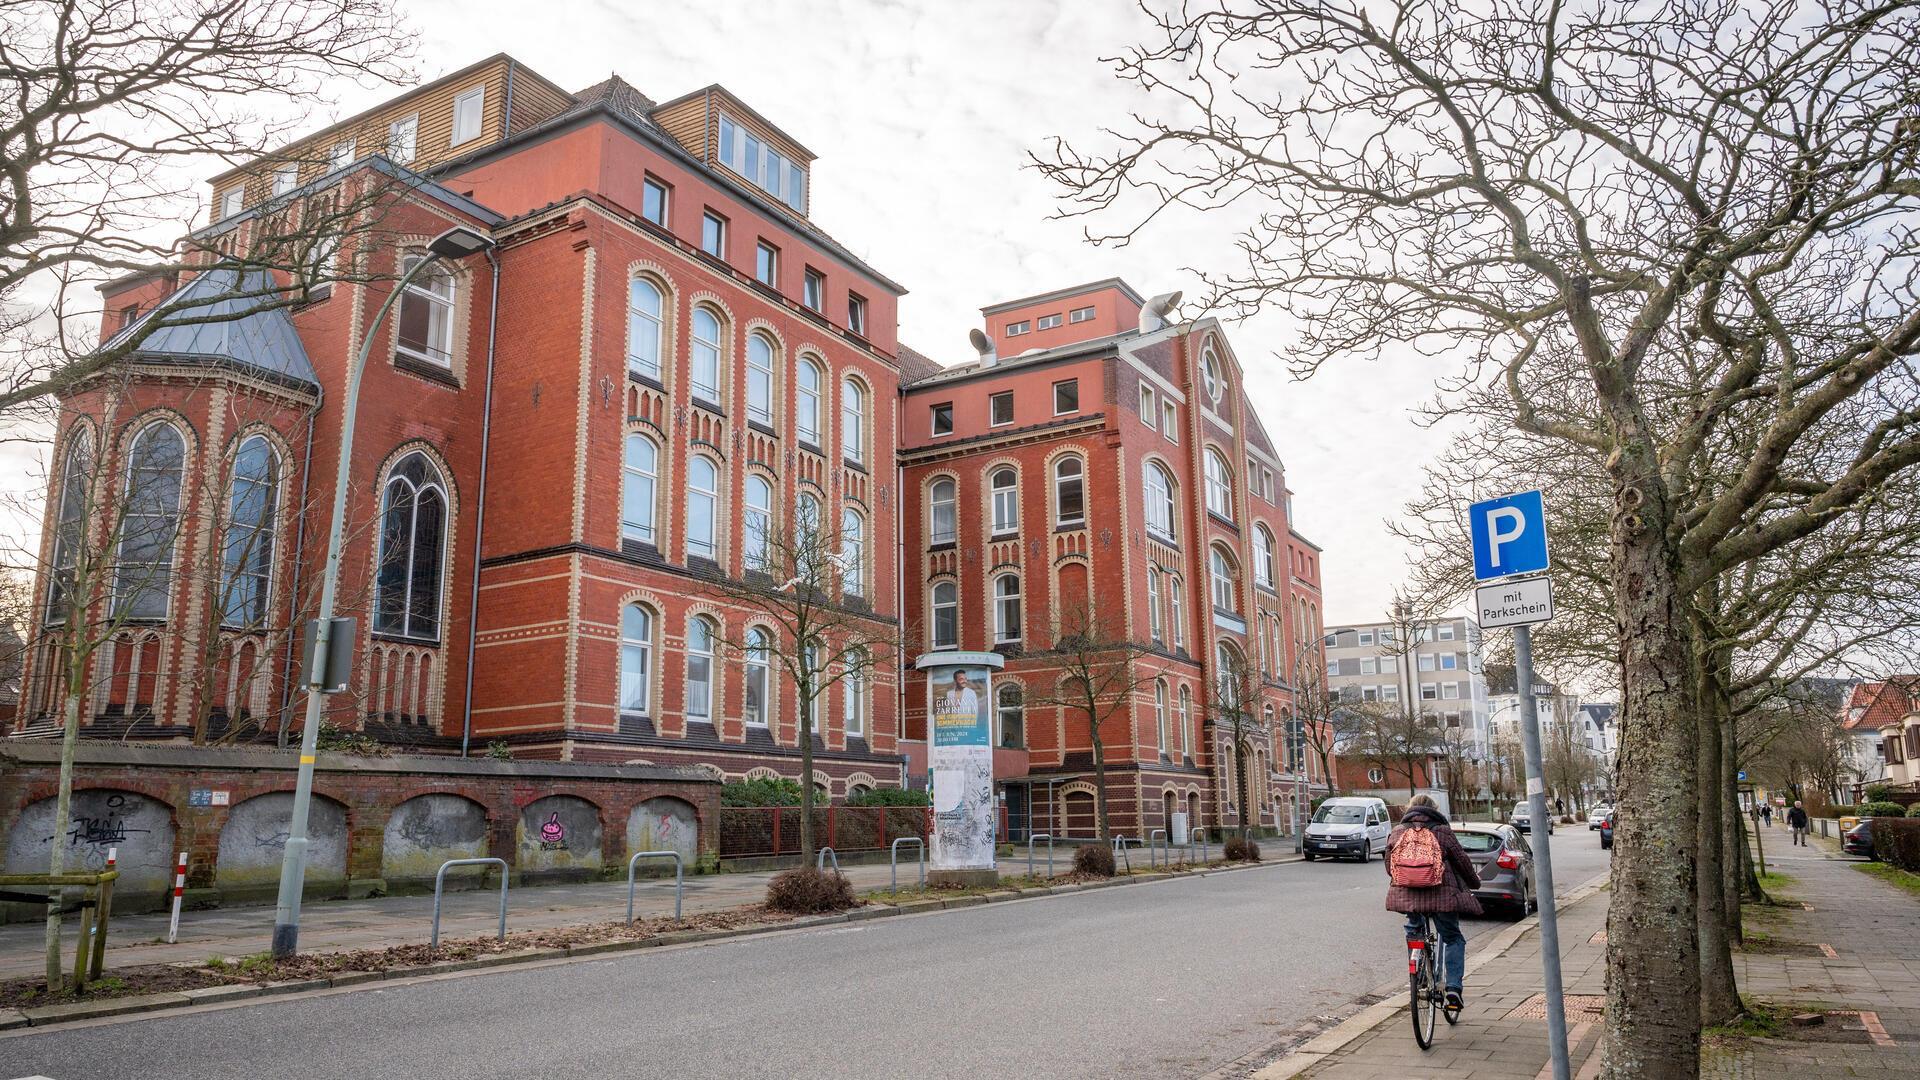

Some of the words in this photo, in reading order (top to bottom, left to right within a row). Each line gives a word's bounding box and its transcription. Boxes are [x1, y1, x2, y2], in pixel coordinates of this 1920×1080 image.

[1486, 506, 1526, 568] P
[1503, 591, 1522, 603] mit
[1483, 602, 1547, 620] Parkschein
